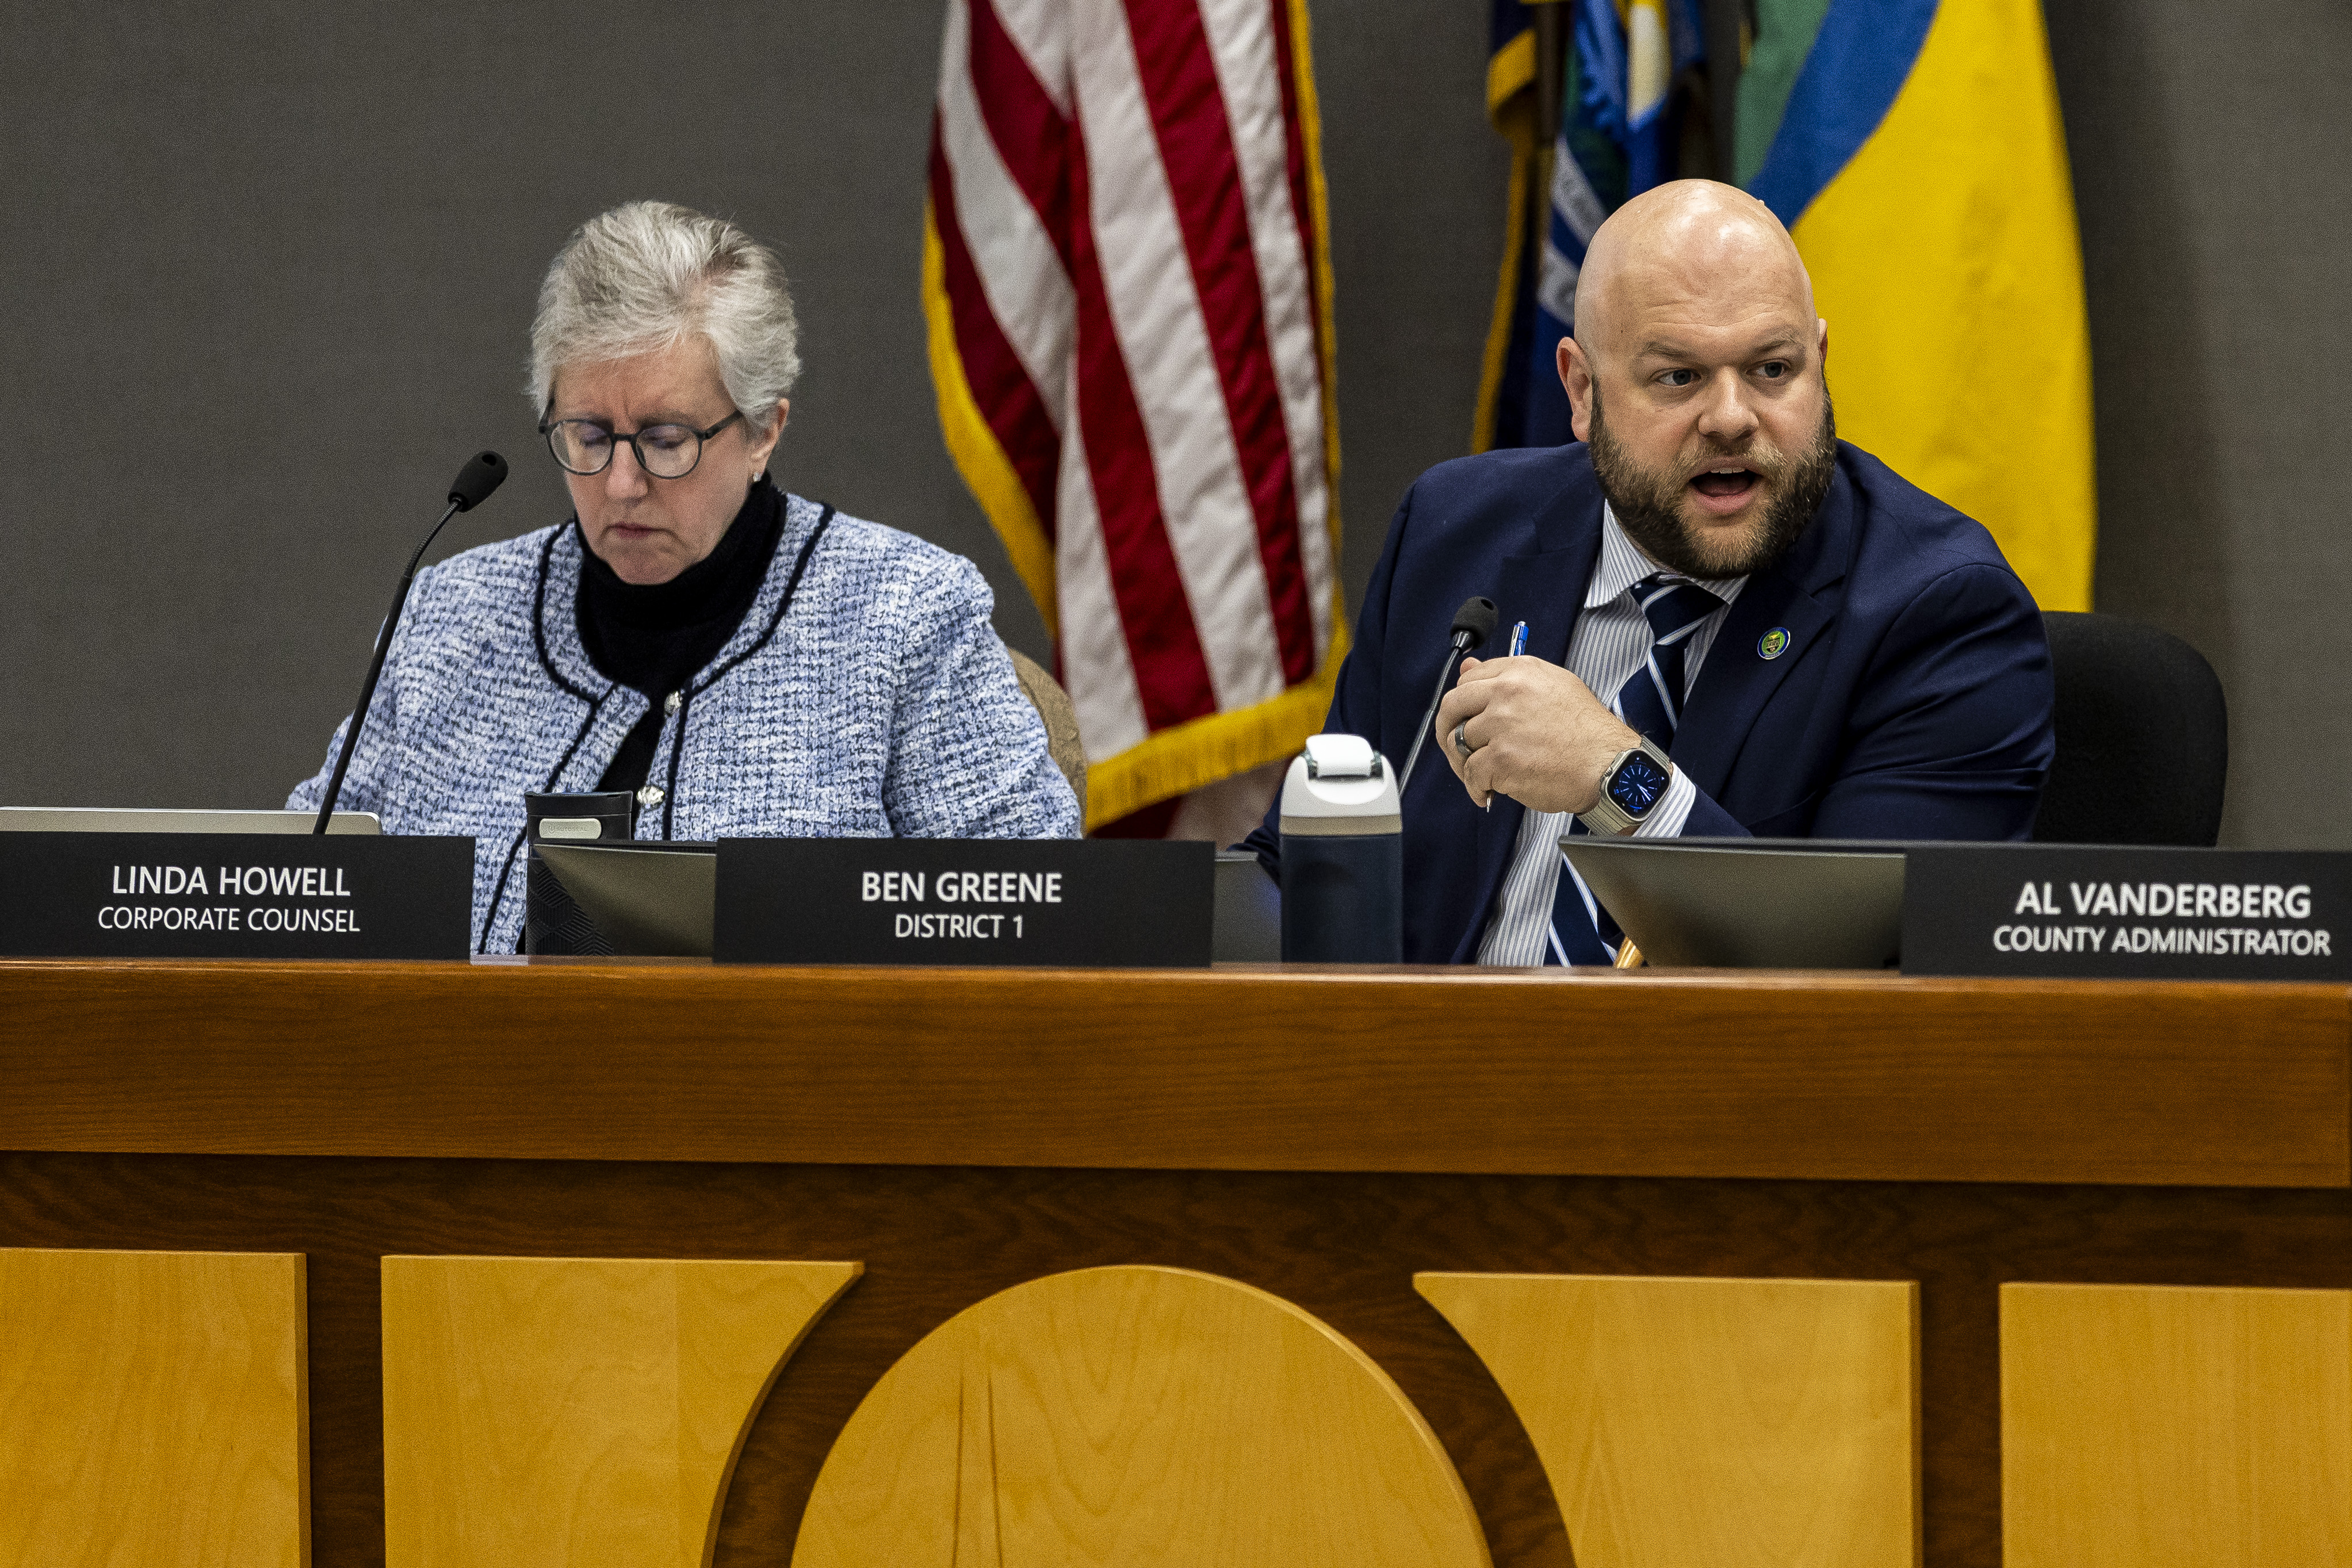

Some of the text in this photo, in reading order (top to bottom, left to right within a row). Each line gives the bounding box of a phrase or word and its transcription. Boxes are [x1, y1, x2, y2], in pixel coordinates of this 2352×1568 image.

[113, 865, 351, 896] LINDA HOWELL
[862, 871, 1062, 903] BEN GREENE
[2015, 882, 2311, 919] AL VANDERBERG
[98, 906, 361, 932] CORPORATE COUNSEL
[895, 913, 1023, 939] DISTRICT 1
[1993, 925, 2331, 956] COUNTY ADMINISTRATOR
